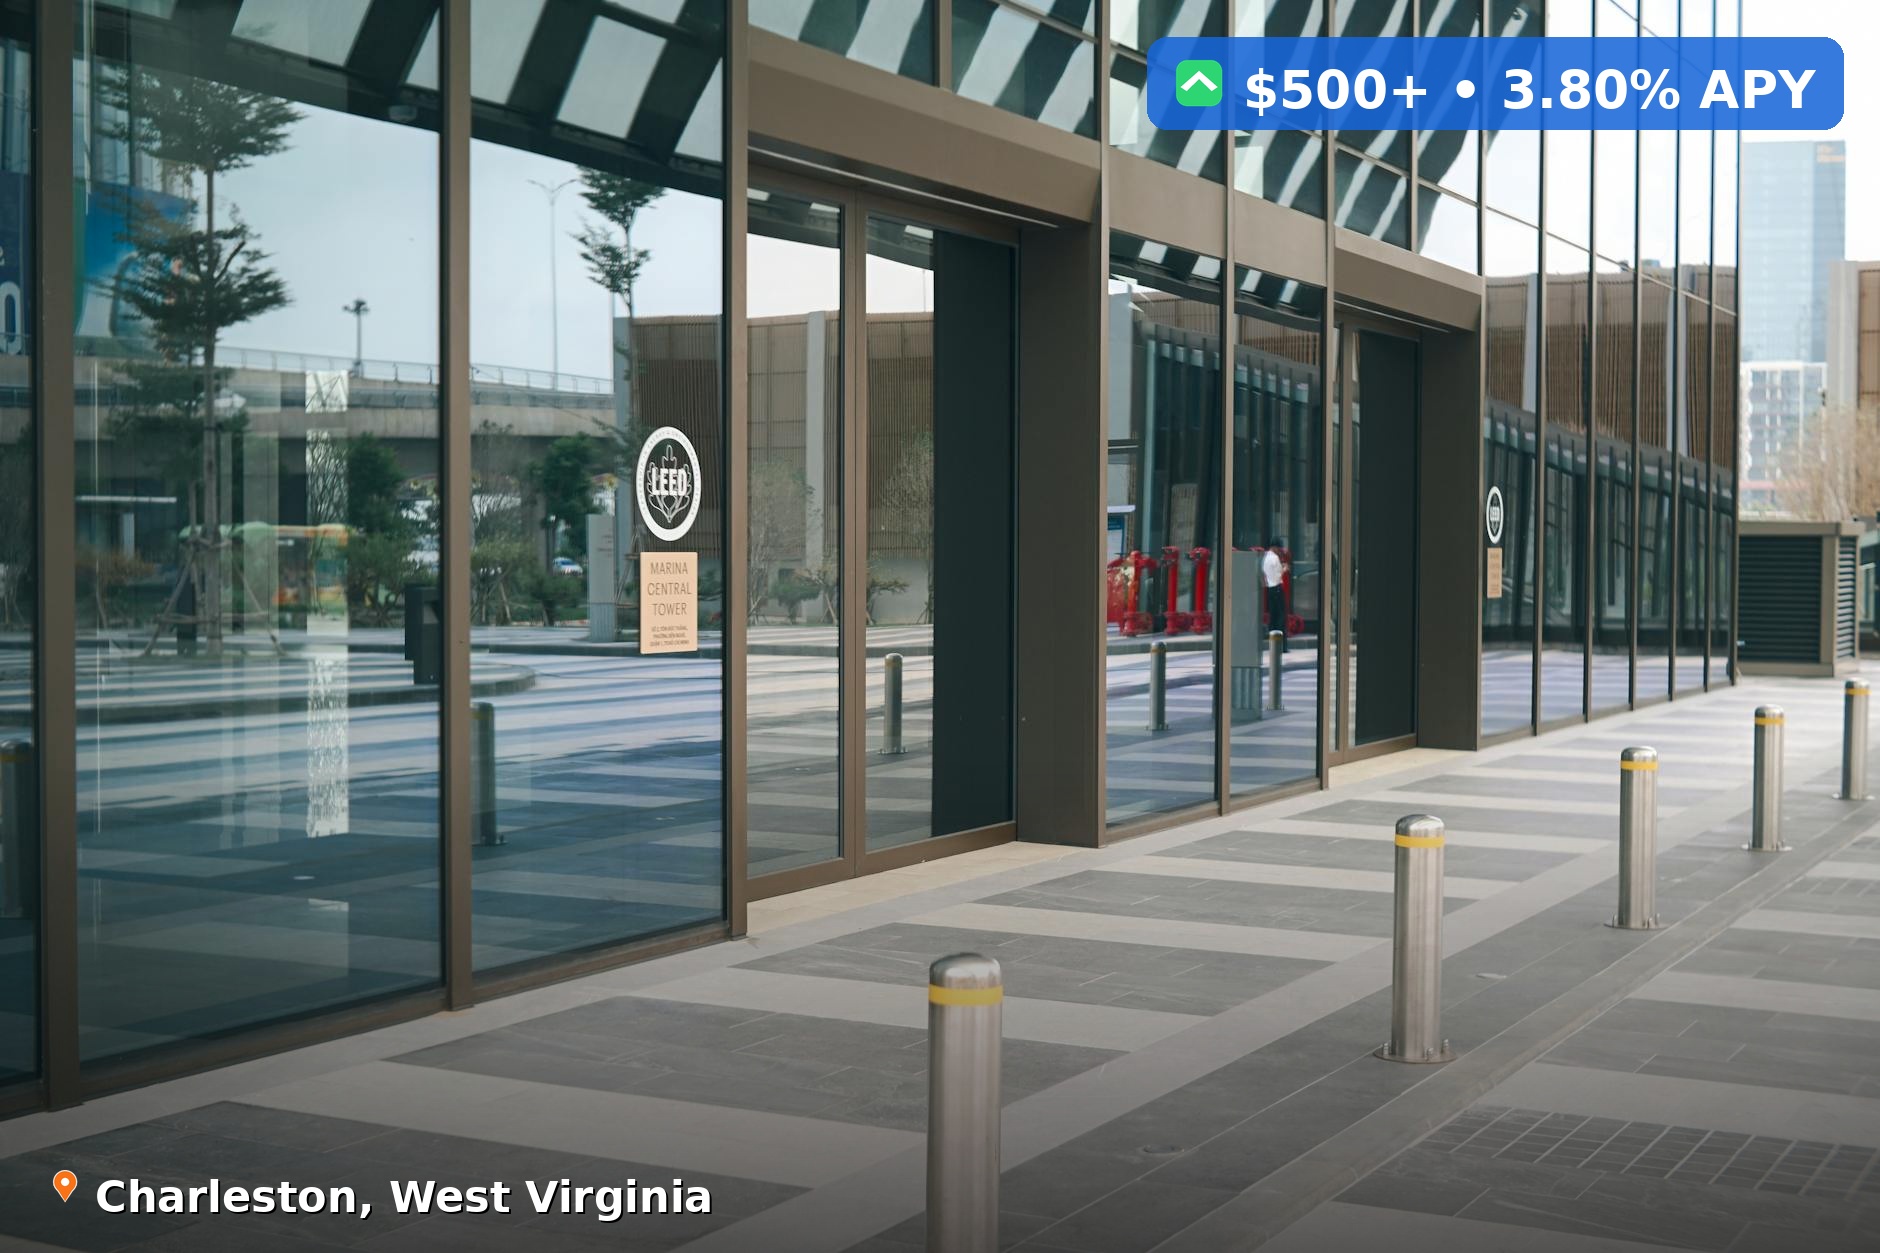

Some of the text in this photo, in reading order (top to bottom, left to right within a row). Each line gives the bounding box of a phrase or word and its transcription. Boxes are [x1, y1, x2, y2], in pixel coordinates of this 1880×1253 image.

[651, 467, 688, 496] LEED
[650, 561, 688, 575] MARINA
[647, 581, 692, 596] CENTRAL
[652, 602, 687, 616] TOWER
